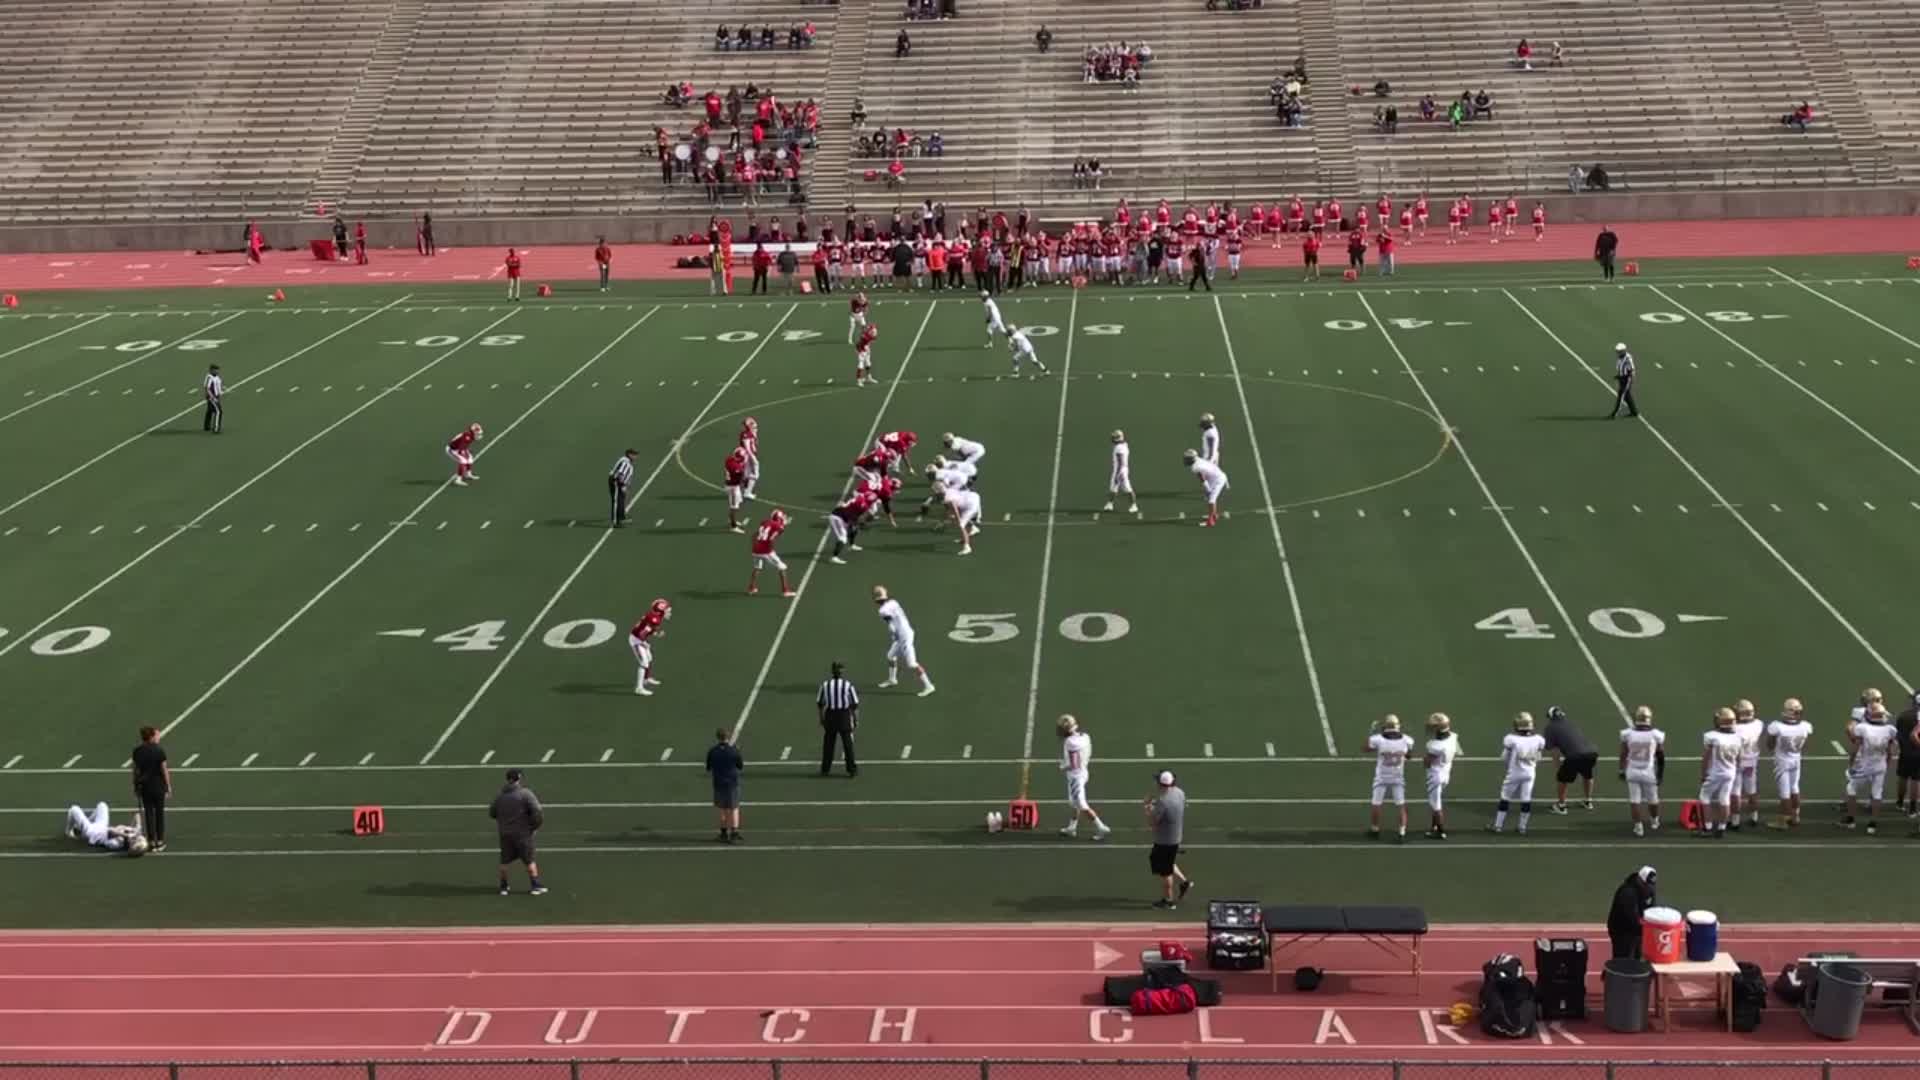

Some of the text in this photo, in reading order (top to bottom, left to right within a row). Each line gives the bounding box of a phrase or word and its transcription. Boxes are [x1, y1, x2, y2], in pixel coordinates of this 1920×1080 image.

[715, 329, 824, 343] 40
[1323, 317, 1434, 331] 40
[433, 618, 617, 652] 40
[947, 611, 1130, 644] 50
[1474, 607, 1666, 639] 40
[0, 626, 112, 656] 0
[357, 810, 380, 832] 40
[1010, 804, 1034, 829] 50
[436, 1007, 1586, 1045] DUTCH CLARK
